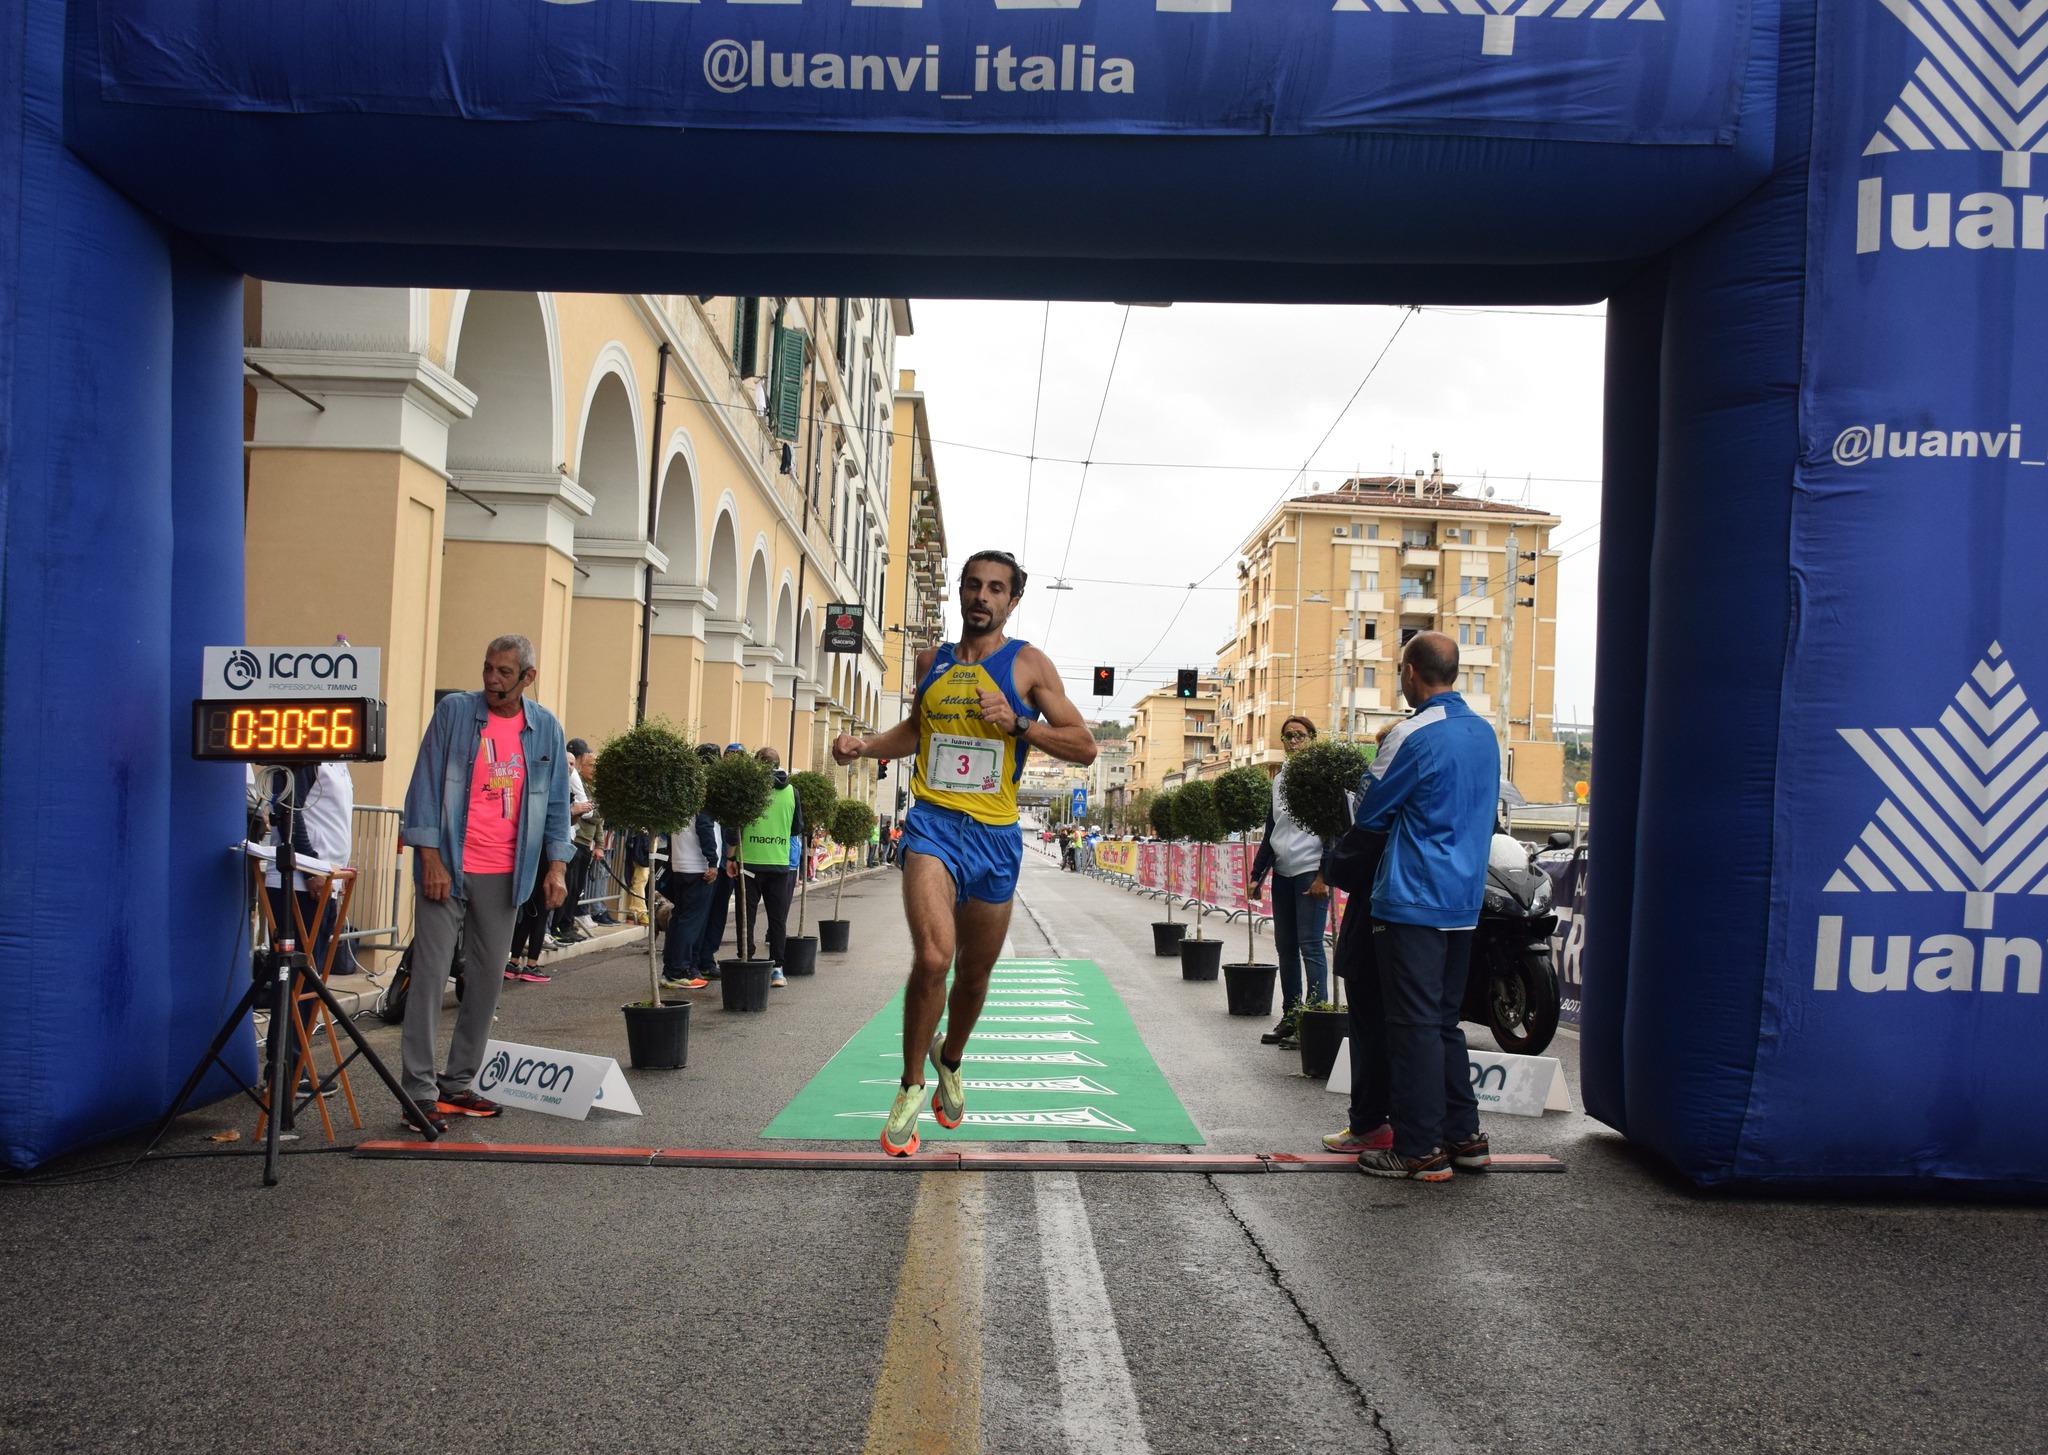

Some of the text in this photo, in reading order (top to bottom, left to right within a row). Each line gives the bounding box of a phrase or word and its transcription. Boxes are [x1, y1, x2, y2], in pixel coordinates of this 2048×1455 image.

[703, 39, 1136, 99] @luanvi_italia
[1832, 424, 2048, 466] @luanvi_
[952, 671, 976, 679] GOBA
[269, 683, 325, 691] PROFESSIONAL
[957, 755, 970, 776] 3
[749, 835, 787, 846] macron
[1813, 915, 2048, 994] luan
[1474, 1092, 1501, 1102] IMING
[931, 1113, 1091, 1124] STAMU
